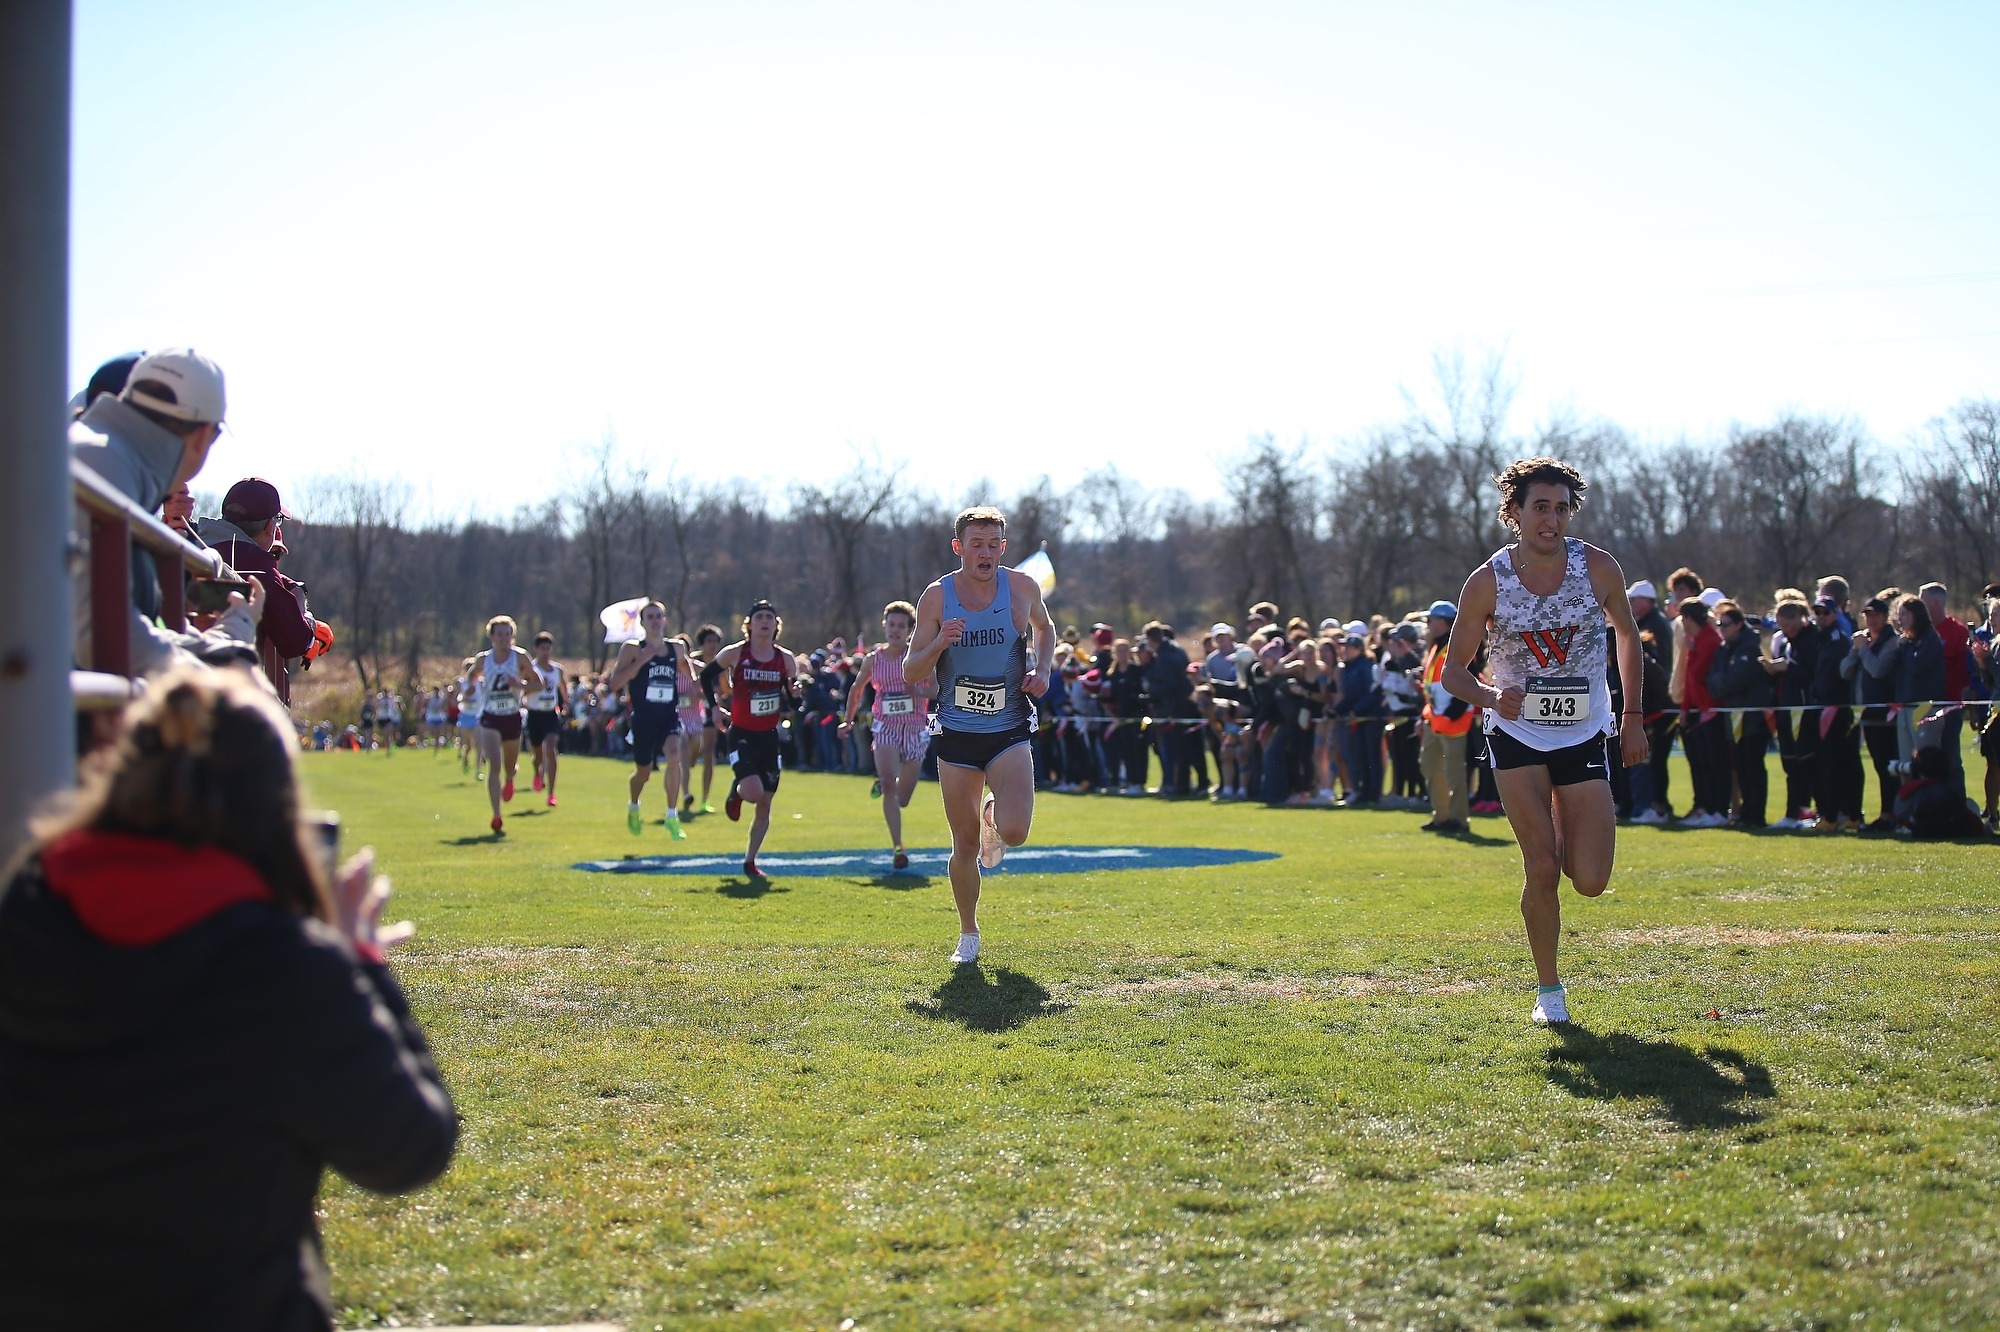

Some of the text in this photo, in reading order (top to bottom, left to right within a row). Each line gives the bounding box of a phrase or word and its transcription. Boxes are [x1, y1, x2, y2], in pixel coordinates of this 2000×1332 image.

[1519, 625, 1580, 668] W
[649, 665, 675, 679] BERRY
[743, 668, 780, 682] LYNCHBURG
[758, 700, 775, 712] 231
[967, 690, 996, 709] 324
[1540, 697, 1576, 717] 343
